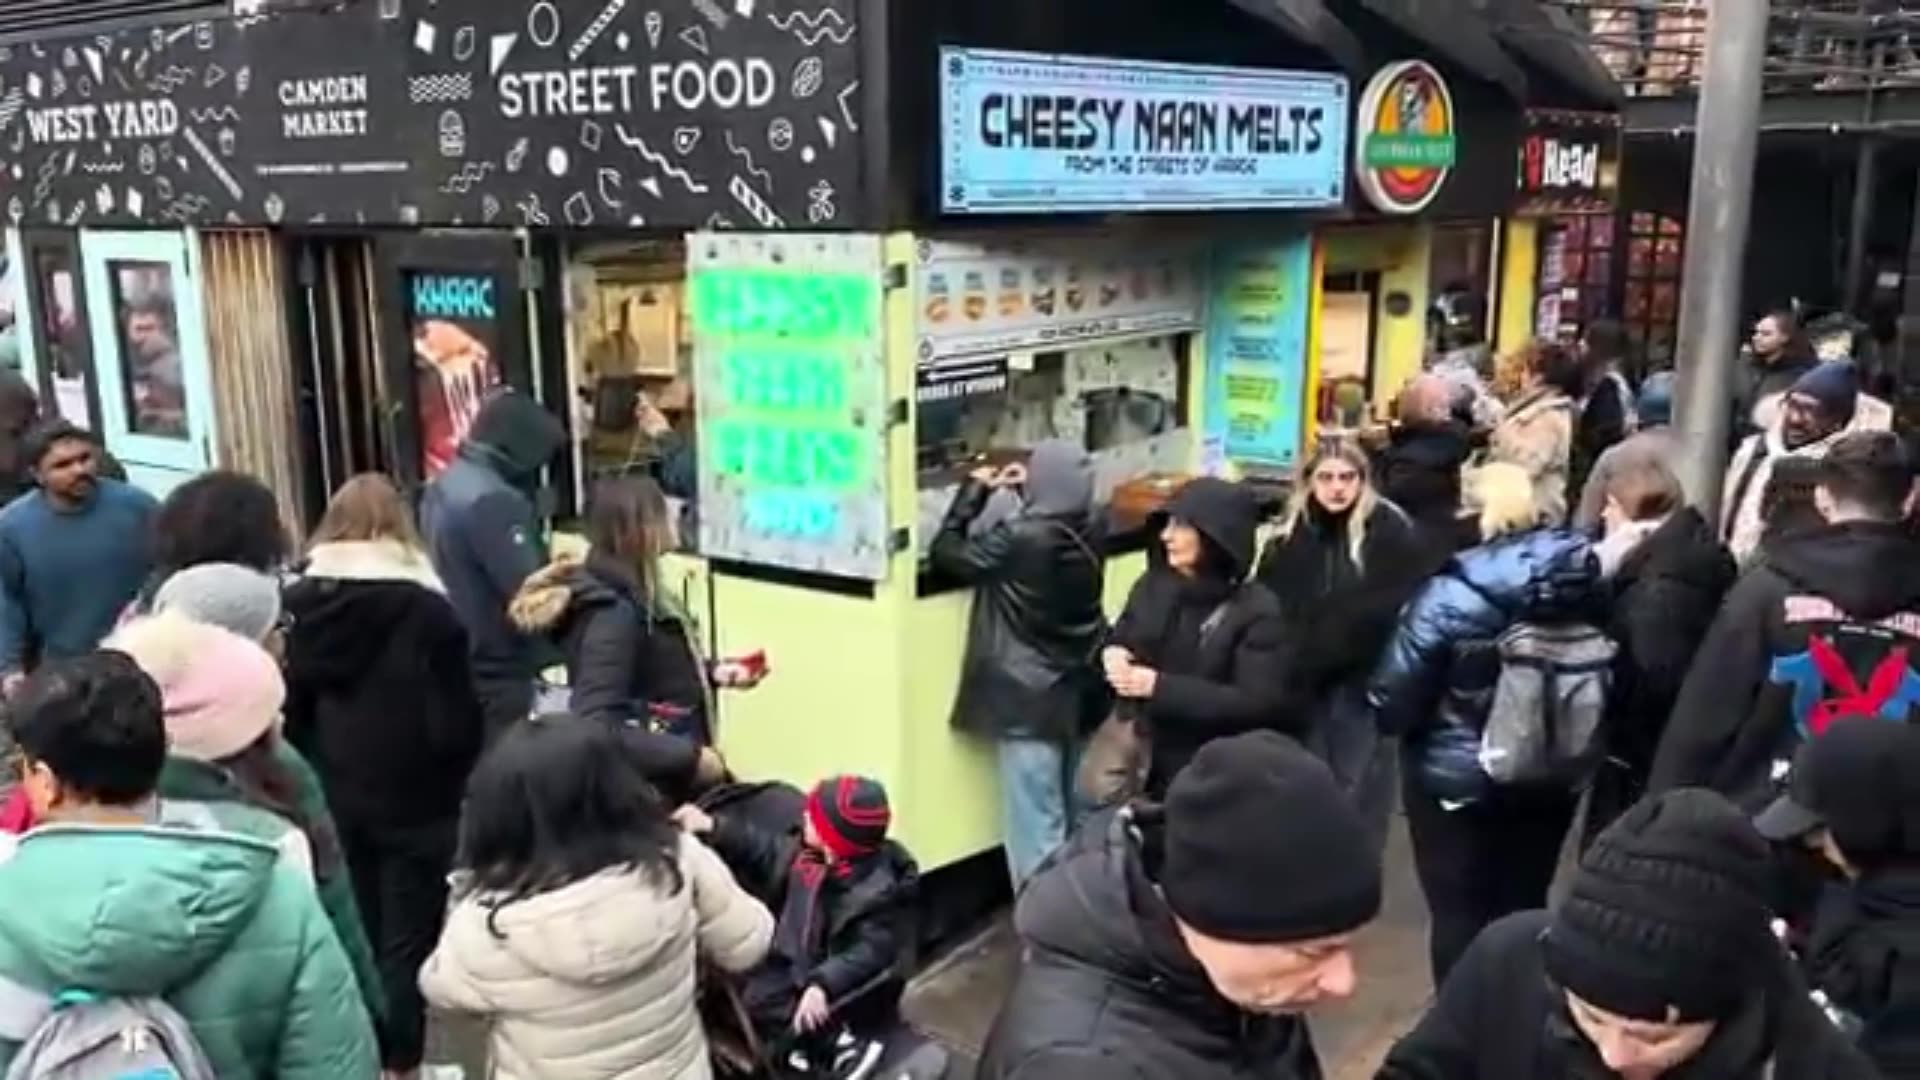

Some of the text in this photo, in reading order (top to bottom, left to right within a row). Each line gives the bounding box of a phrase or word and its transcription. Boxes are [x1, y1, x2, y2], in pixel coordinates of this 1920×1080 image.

[278, 75, 367, 105] CAMDEN
[500, 57, 775, 117] STREET FOOD
[26, 98, 178, 143] WEST YARD
[282, 108, 368, 137] MARKET
[980, 93, 1324, 155] CHEESY NAAN MELTS
